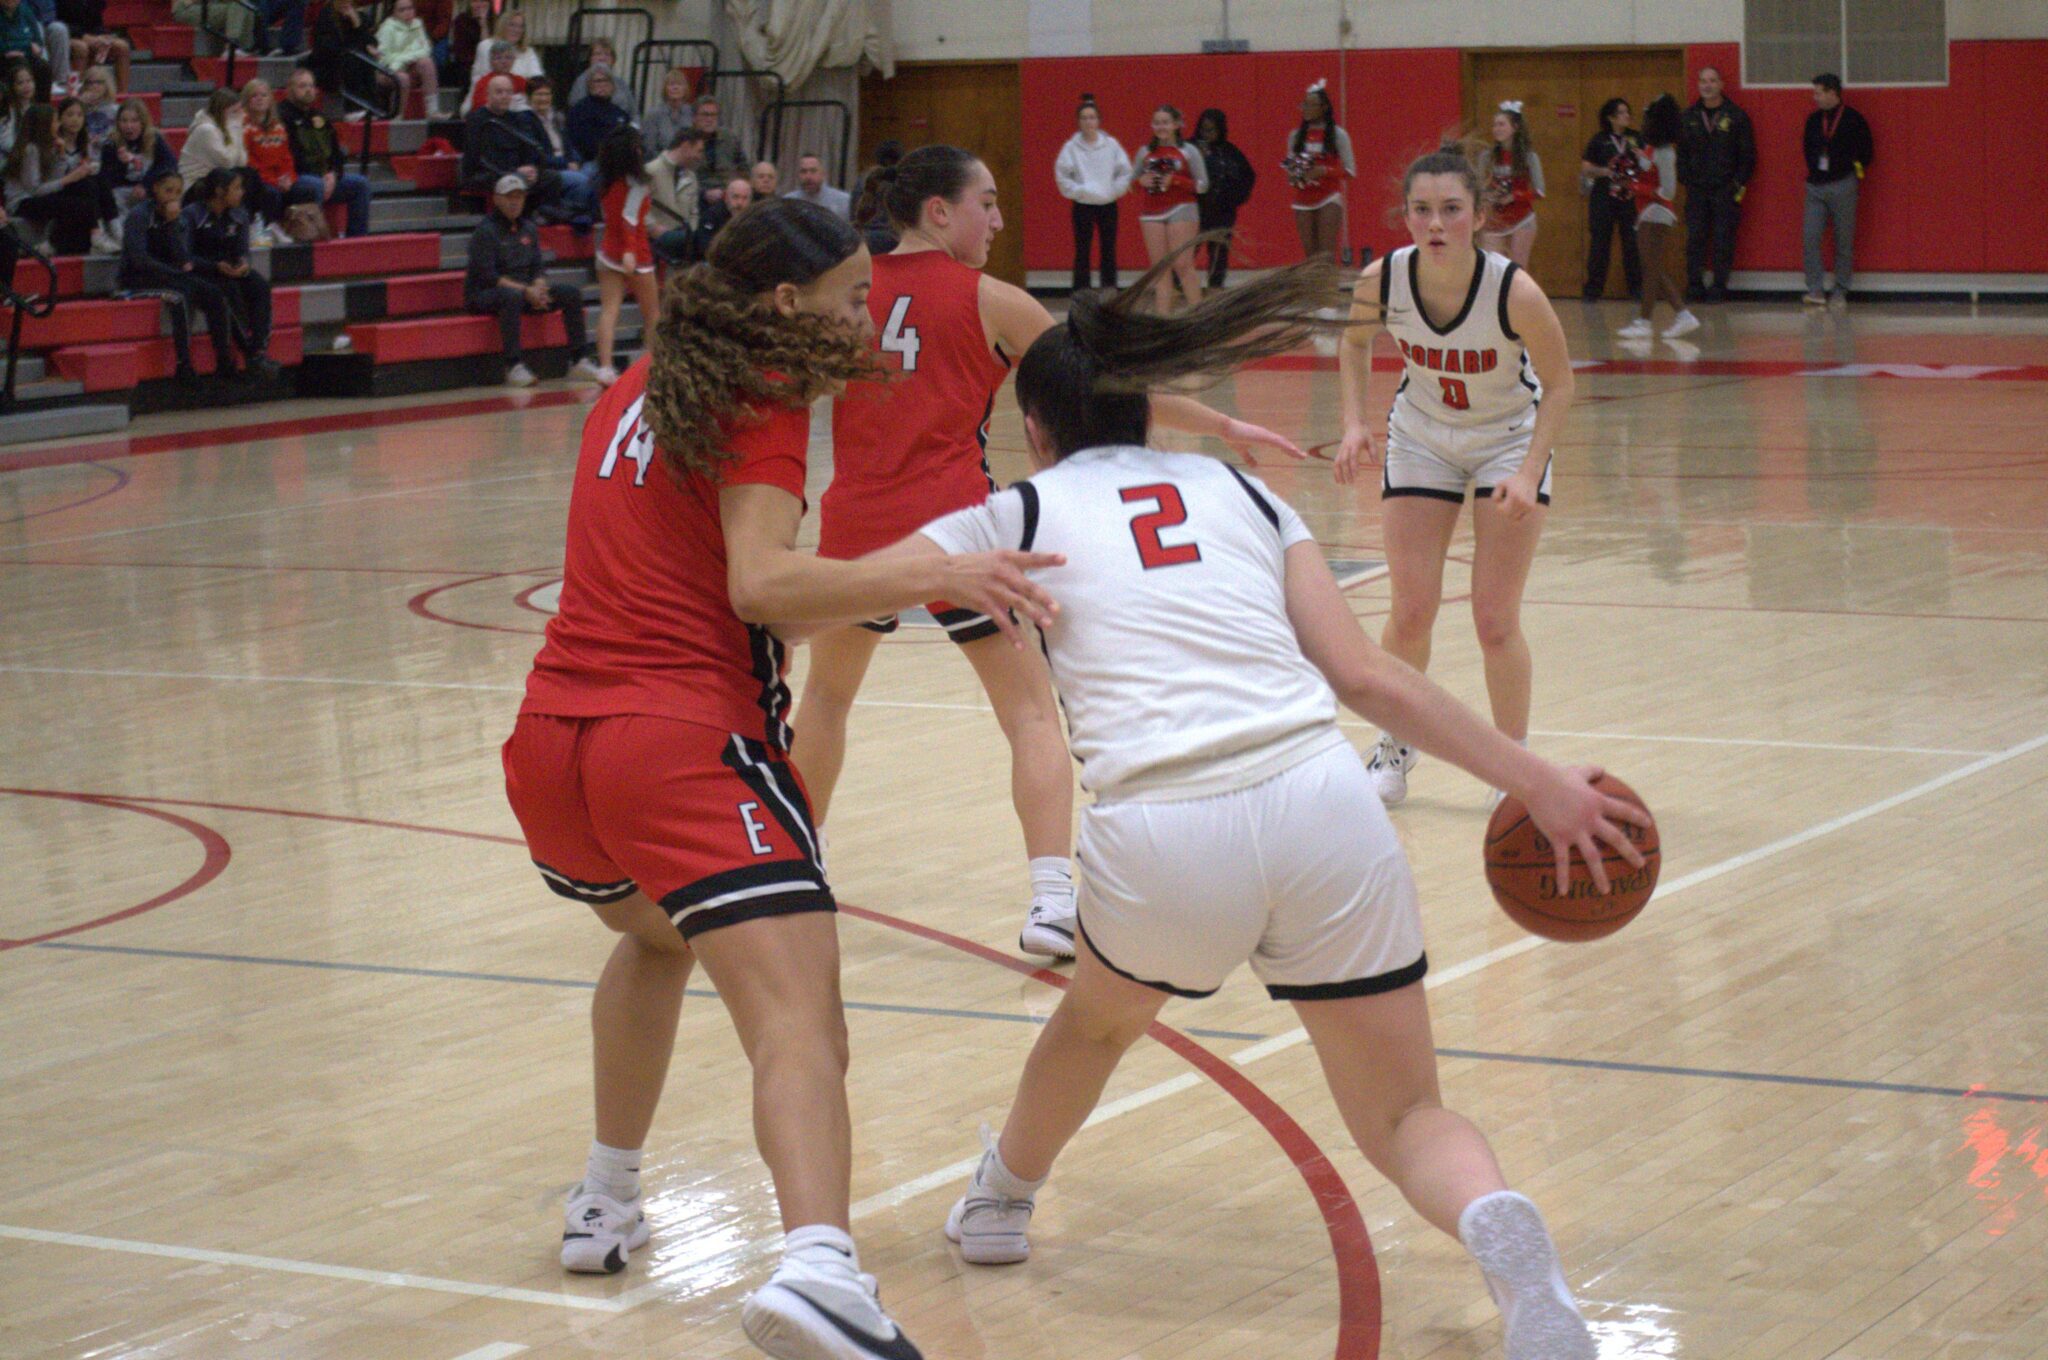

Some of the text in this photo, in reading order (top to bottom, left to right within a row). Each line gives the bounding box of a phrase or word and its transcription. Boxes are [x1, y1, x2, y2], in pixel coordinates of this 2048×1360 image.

[880, 294, 921, 371] 4
[1438, 376, 1471, 411] 0
[597, 391, 656, 487] 14
[1117, 482, 1202, 571] 2
[737, 800, 774, 856] E
